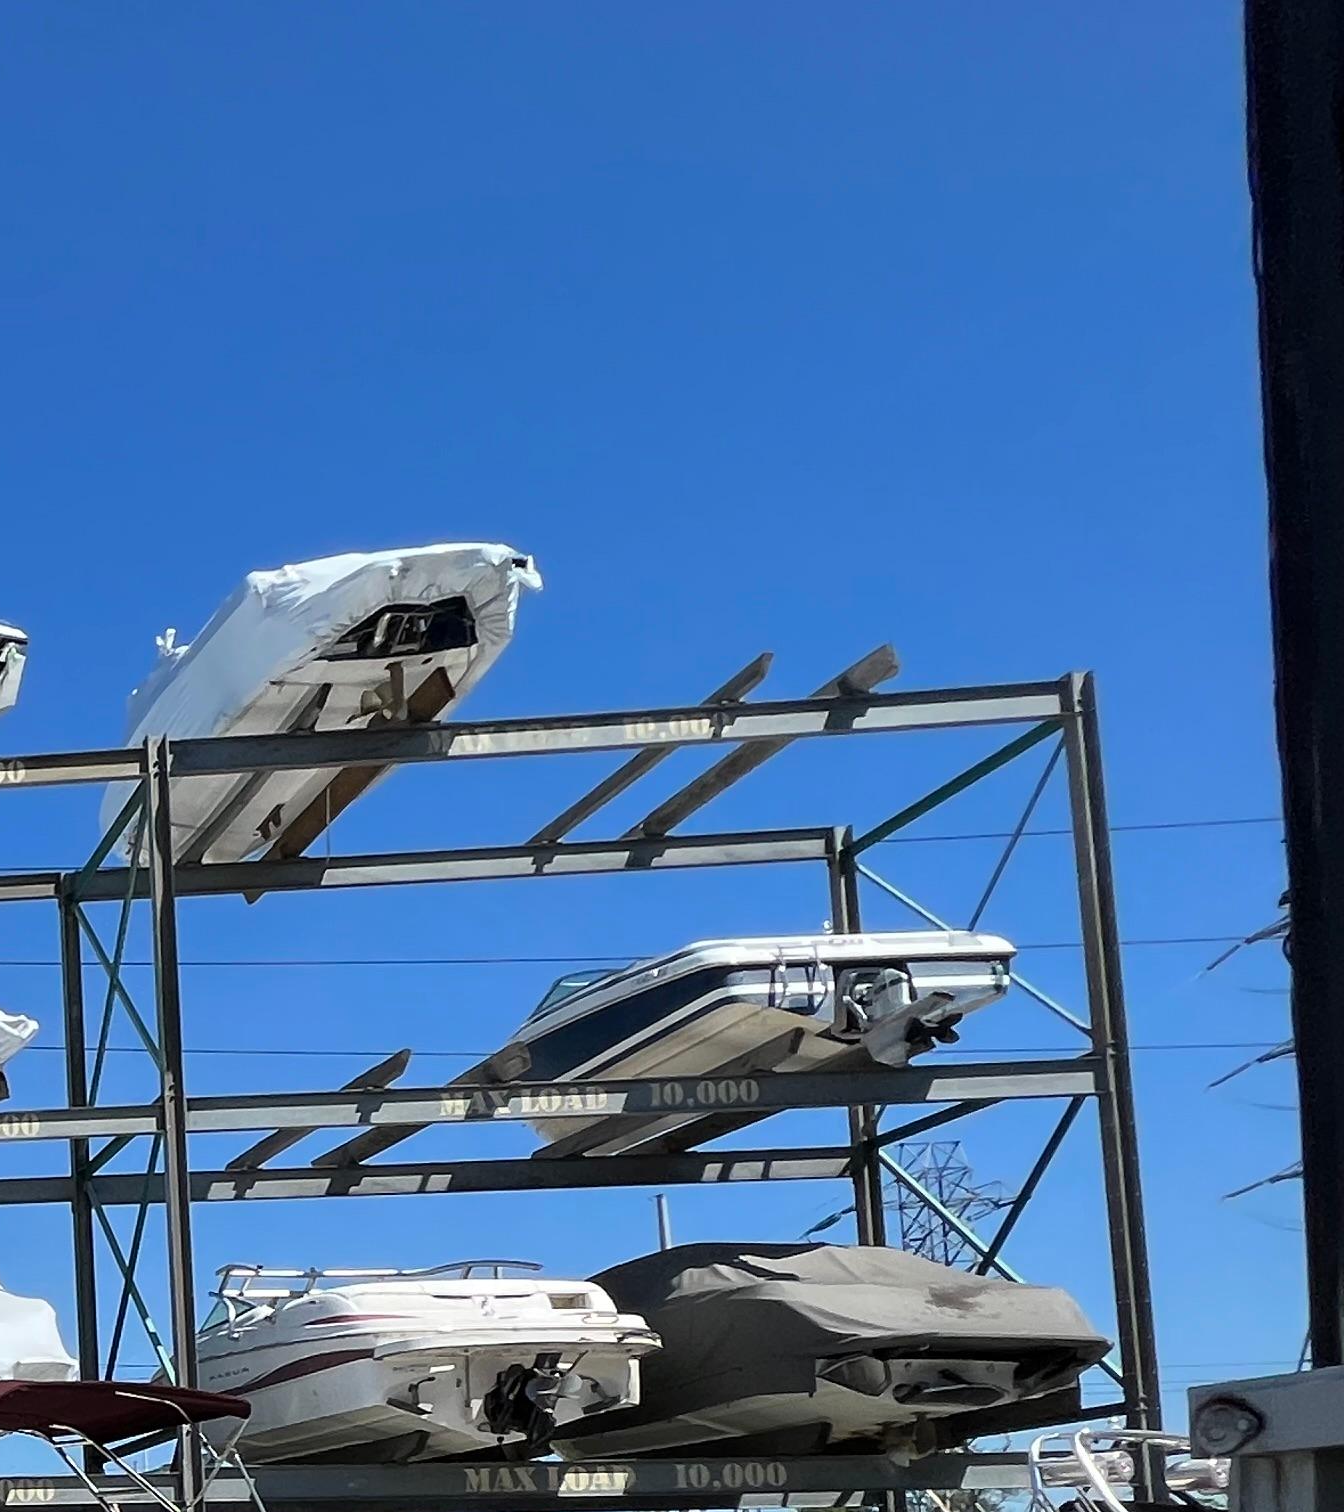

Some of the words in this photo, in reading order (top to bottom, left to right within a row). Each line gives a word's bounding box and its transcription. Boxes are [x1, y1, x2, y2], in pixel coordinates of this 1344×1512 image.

[439, 1089, 513, 1116] MAX
[520, 1085, 609, 1113] LOAD
[463, 1467, 538, 1492] MAX
[547, 1464, 637, 1492] LOAD
